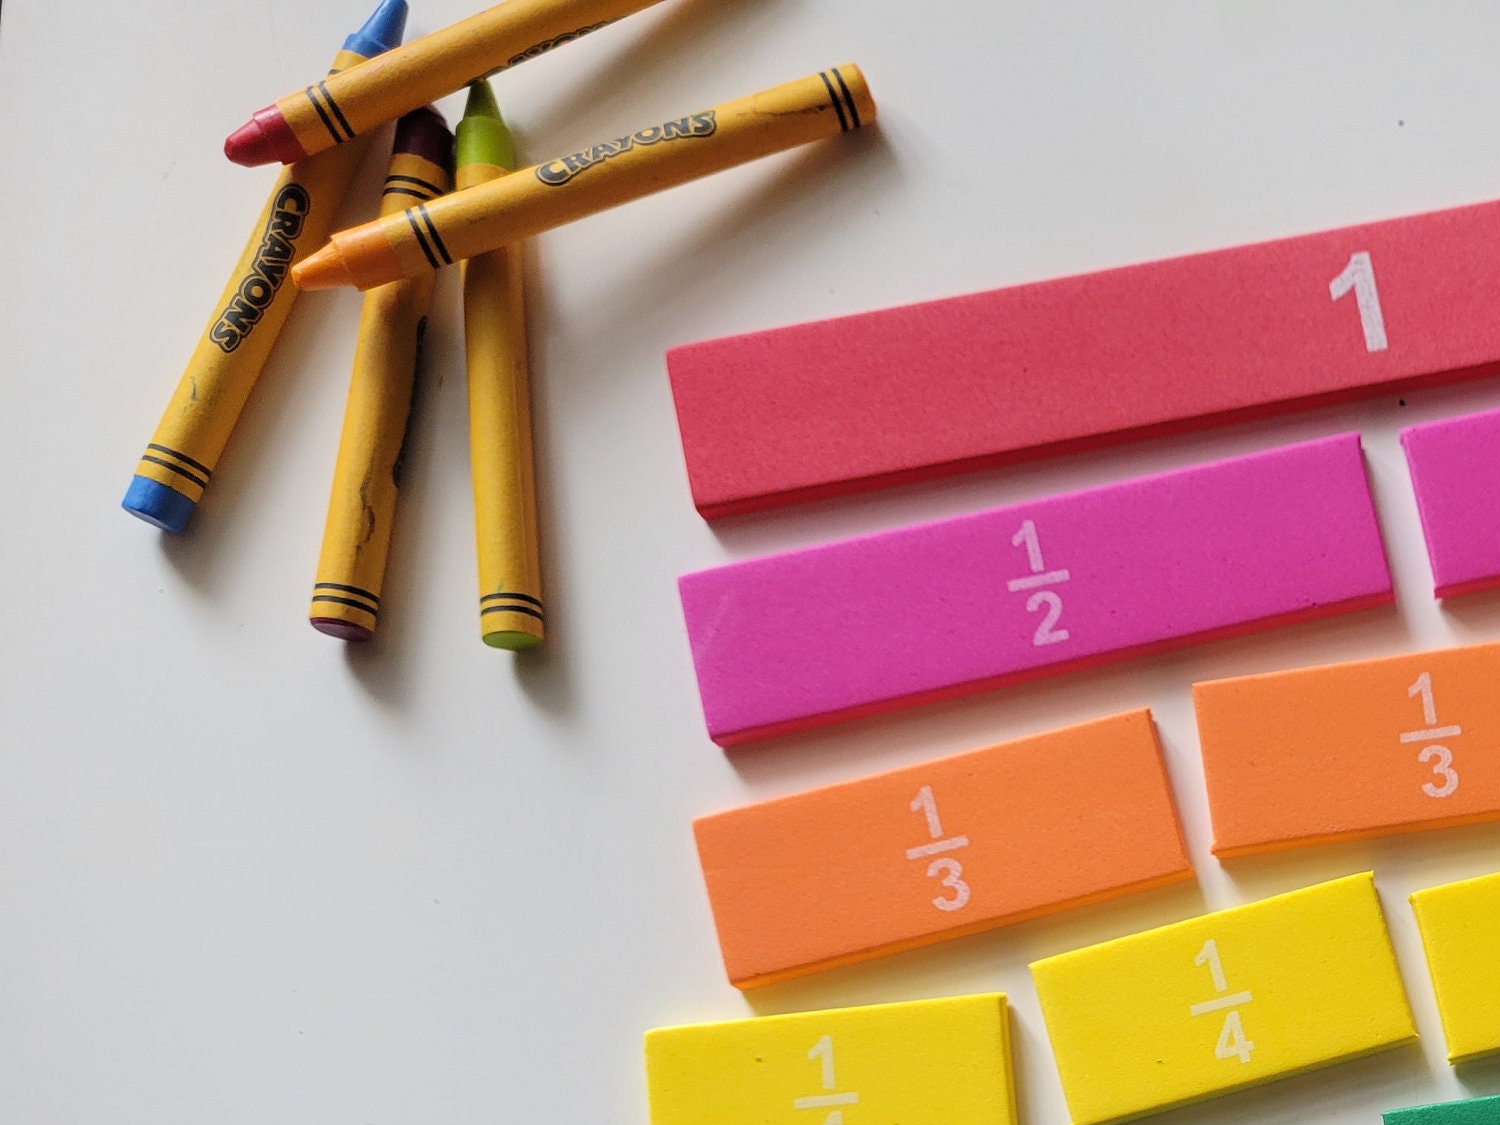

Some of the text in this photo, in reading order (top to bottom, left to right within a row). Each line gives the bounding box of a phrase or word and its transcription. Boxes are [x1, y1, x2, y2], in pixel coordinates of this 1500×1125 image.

[535, 110, 717, 186] CRAYONS
[209, 183, 311, 353] CRAYONS
[1328, 251, 1388, 353] 1
[1012, 520, 1045, 572] 1
[1026, 591, 1069, 646] 2
[1407, 672, 1438, 725] 1
[1417, 744, 1459, 798] 3
[909, 785, 943, 839] 1
[926, 857, 971, 912] 3
[1194, 938, 1229, 993] 1
[807, 1034, 837, 1090] 1
[1214, 1009, 1256, 1064] 4
